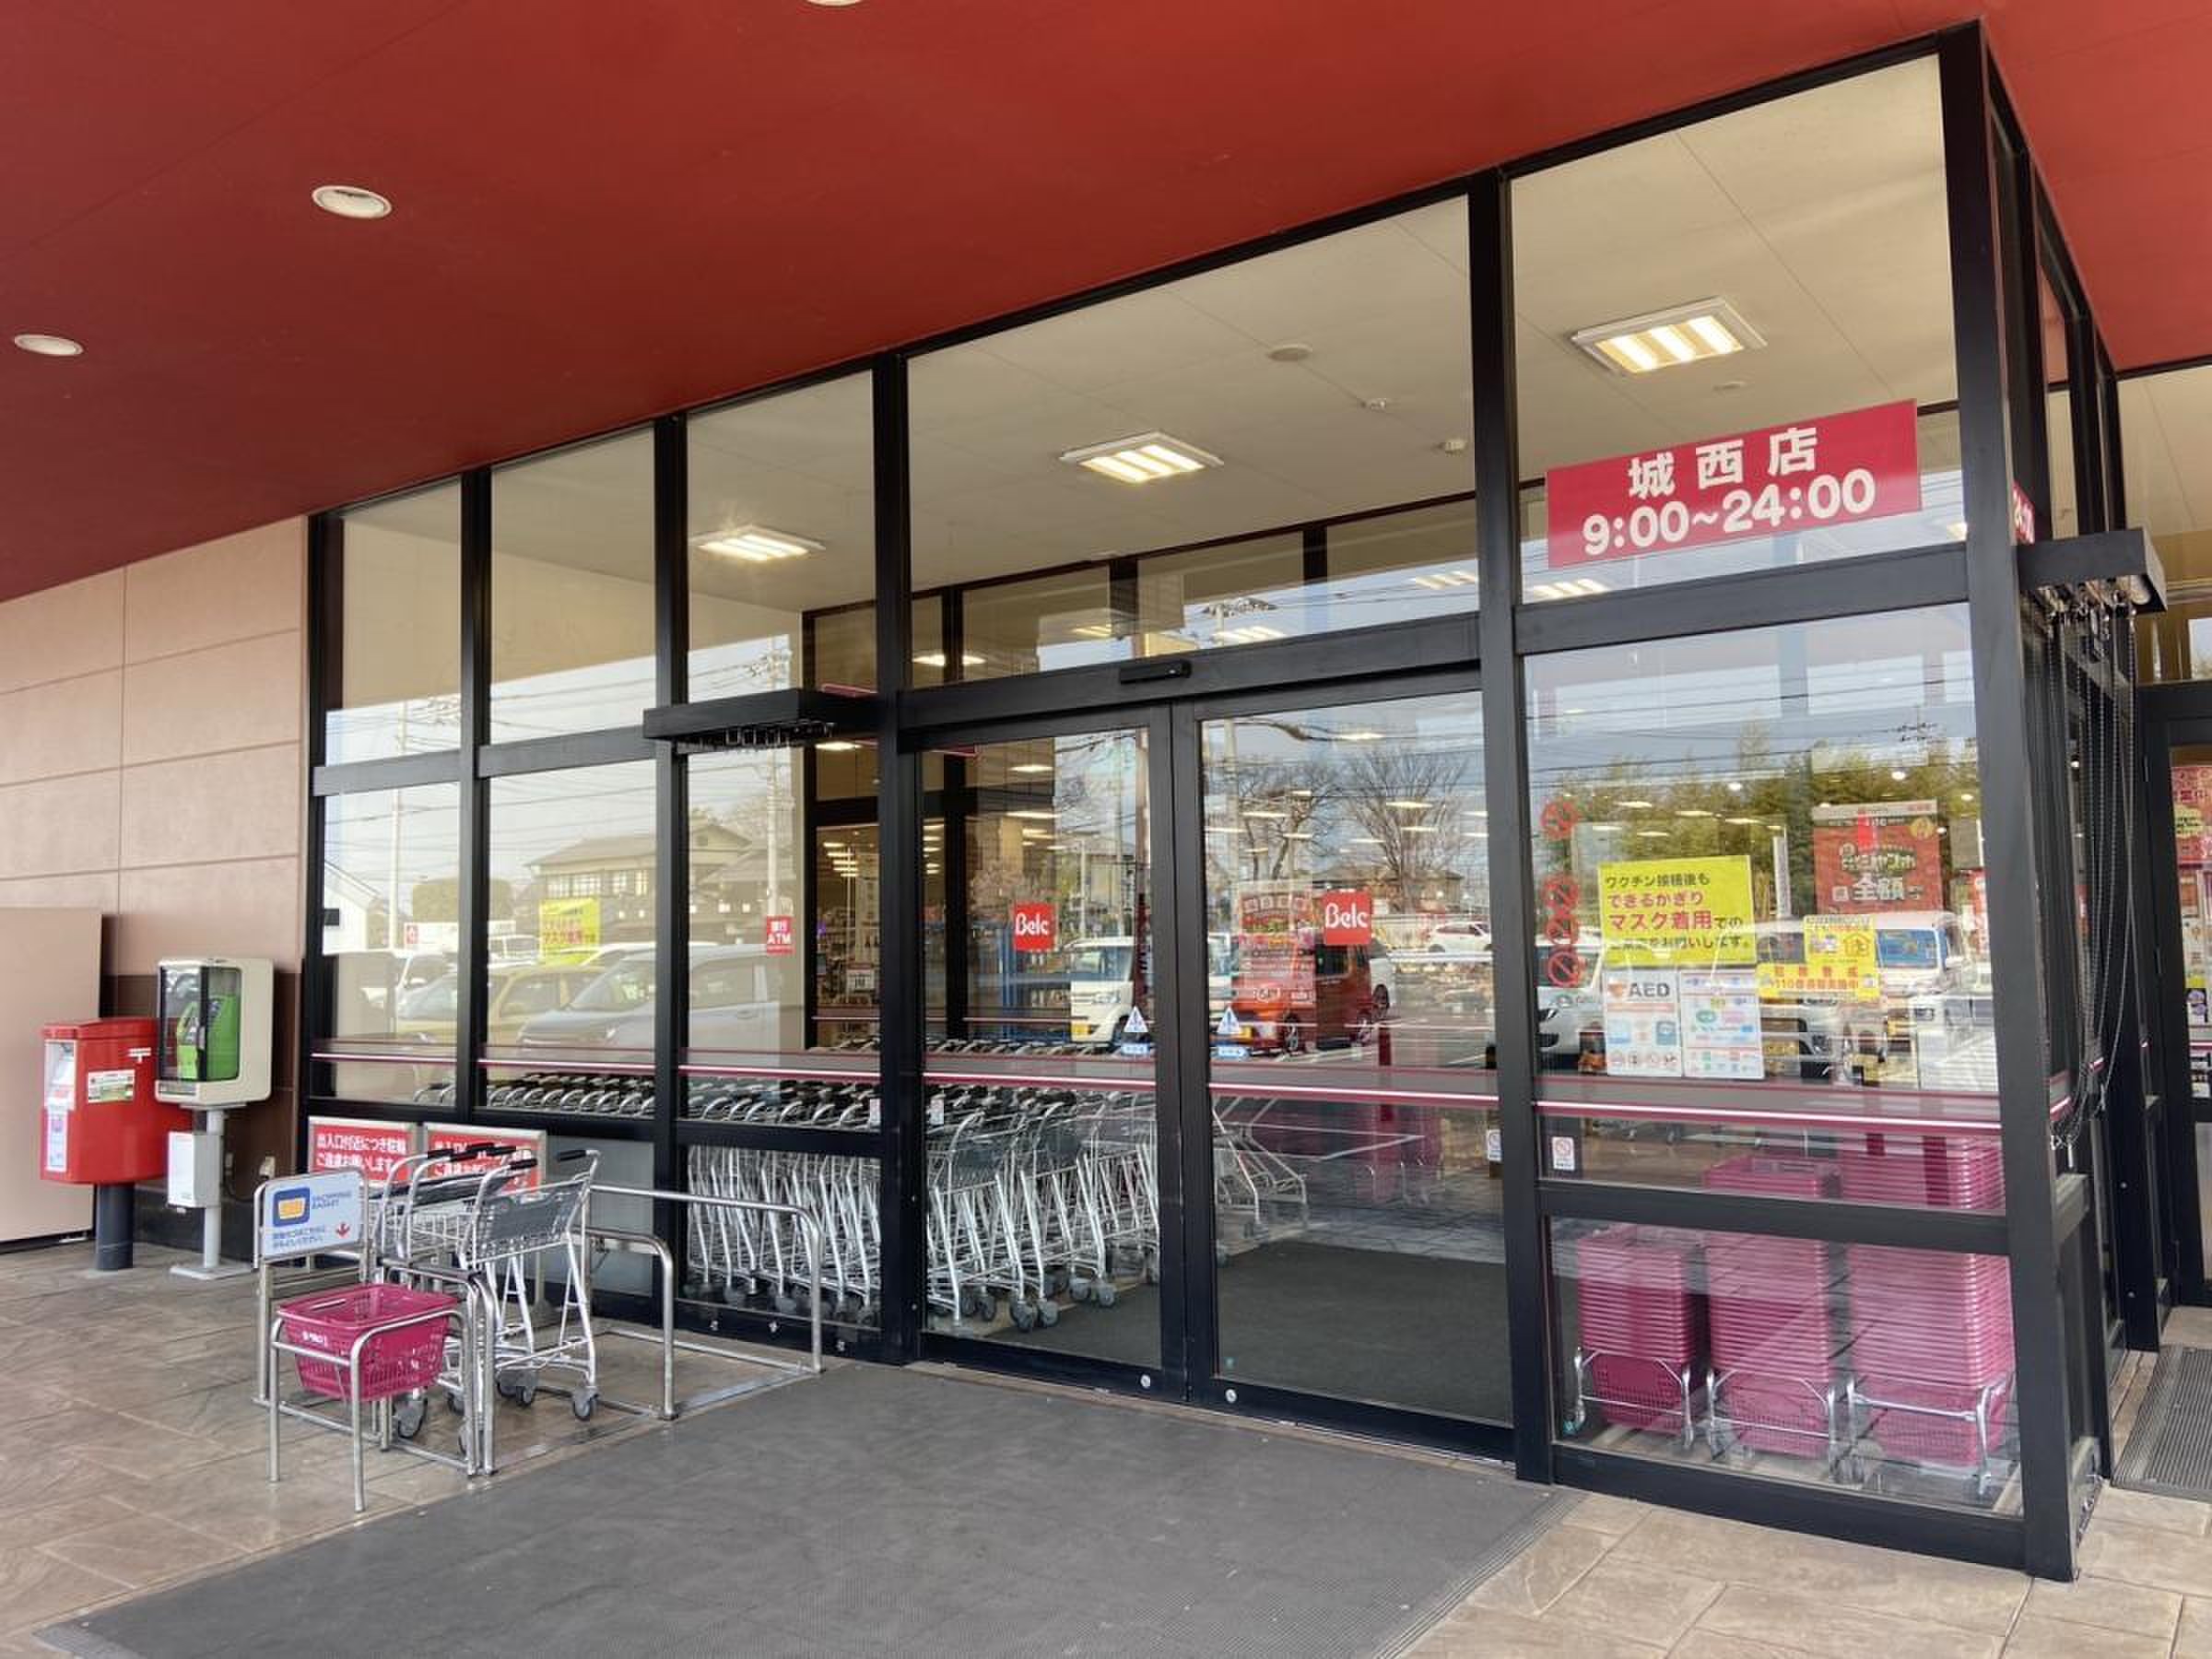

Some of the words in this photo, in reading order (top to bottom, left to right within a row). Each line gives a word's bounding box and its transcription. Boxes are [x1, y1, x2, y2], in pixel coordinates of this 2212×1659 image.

[1628, 427, 1817, 500] 城西店
[1607, 890, 1704, 909] できるかぎり
[1015, 912, 1050, 935] Belc
[1325, 902, 1368, 928] Belc
[1609, 910, 1744, 931] マスク着用での
[767, 932, 793, 945] ATM
[1627, 982, 1670, 998] AED
